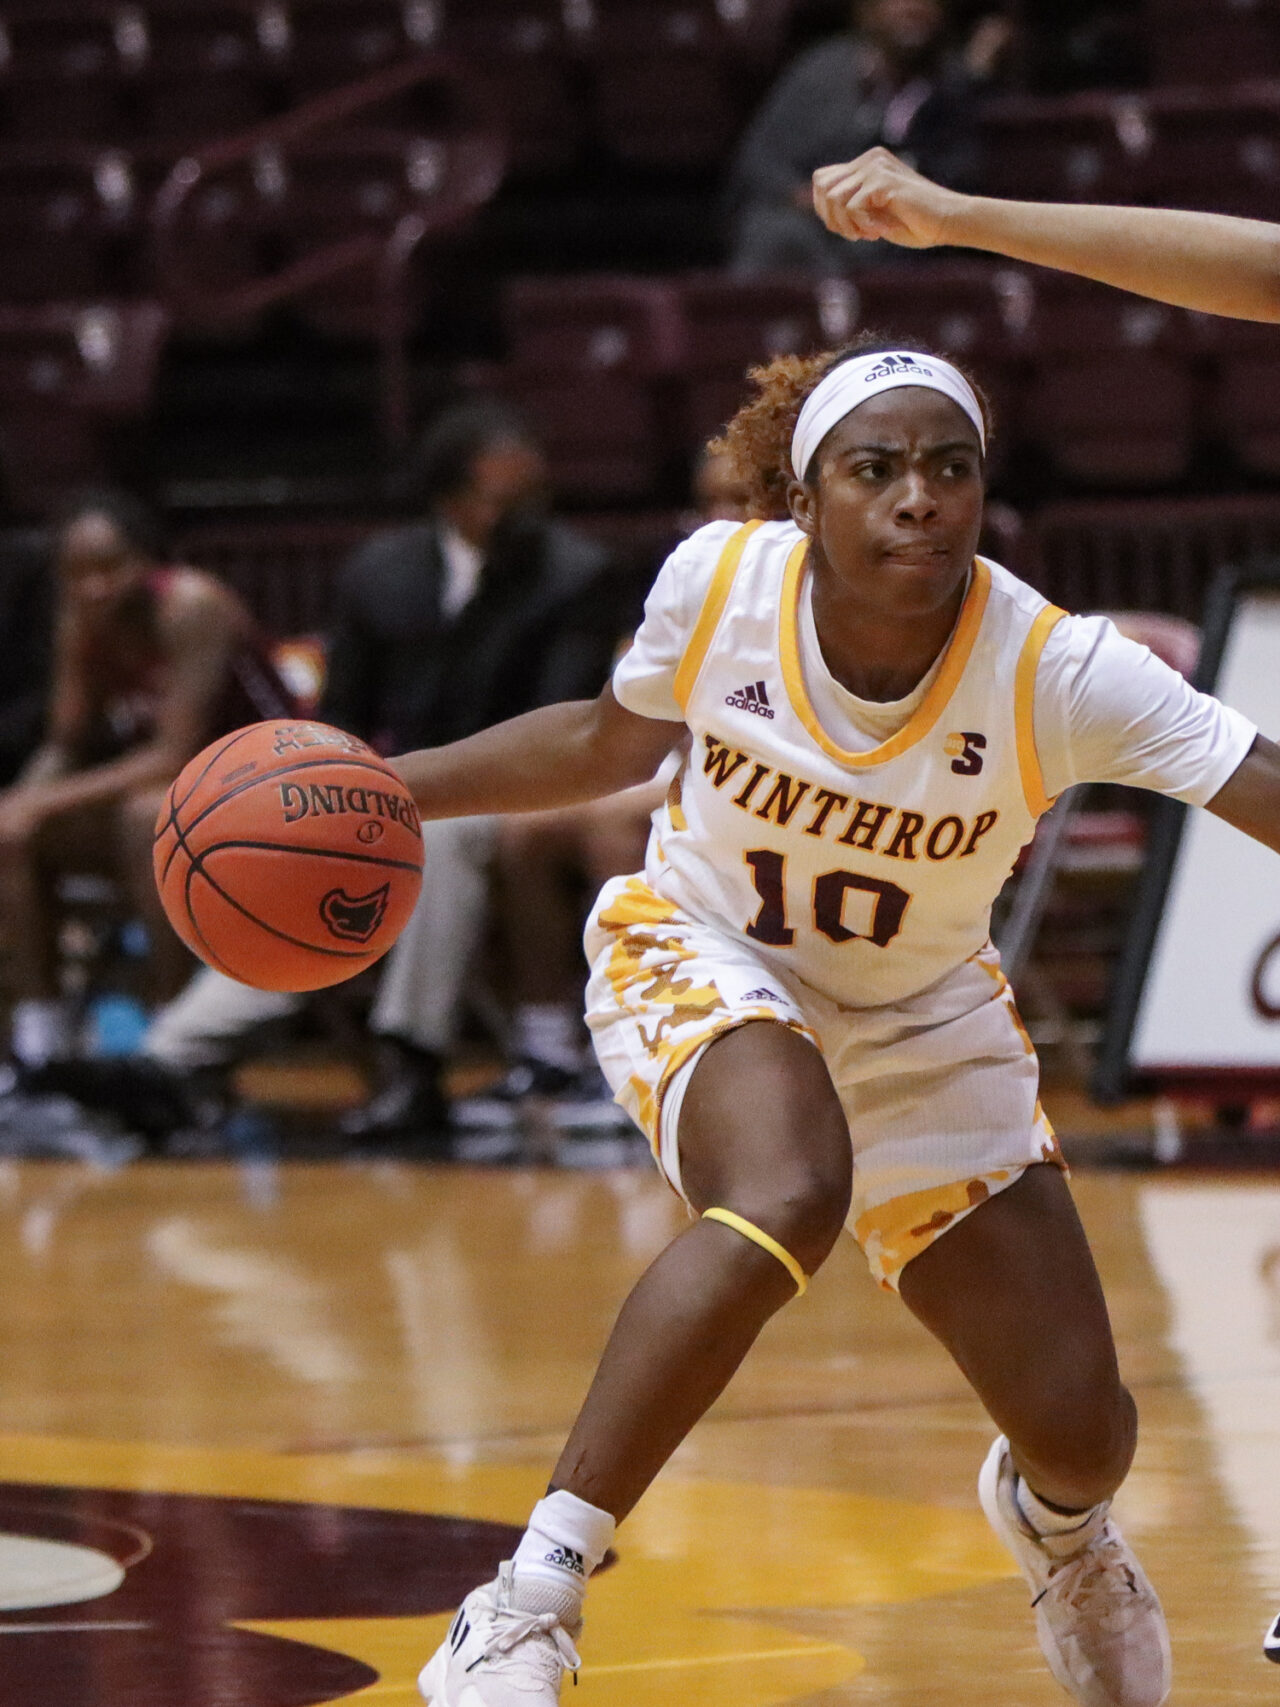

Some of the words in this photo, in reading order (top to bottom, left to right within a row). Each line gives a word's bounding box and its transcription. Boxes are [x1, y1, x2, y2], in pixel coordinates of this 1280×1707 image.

[864, 363, 933, 382] adidas
[725, 695, 775, 720] adidas
[702, 731, 1000, 862] WINTHROP
[742, 847, 914, 949] 10
